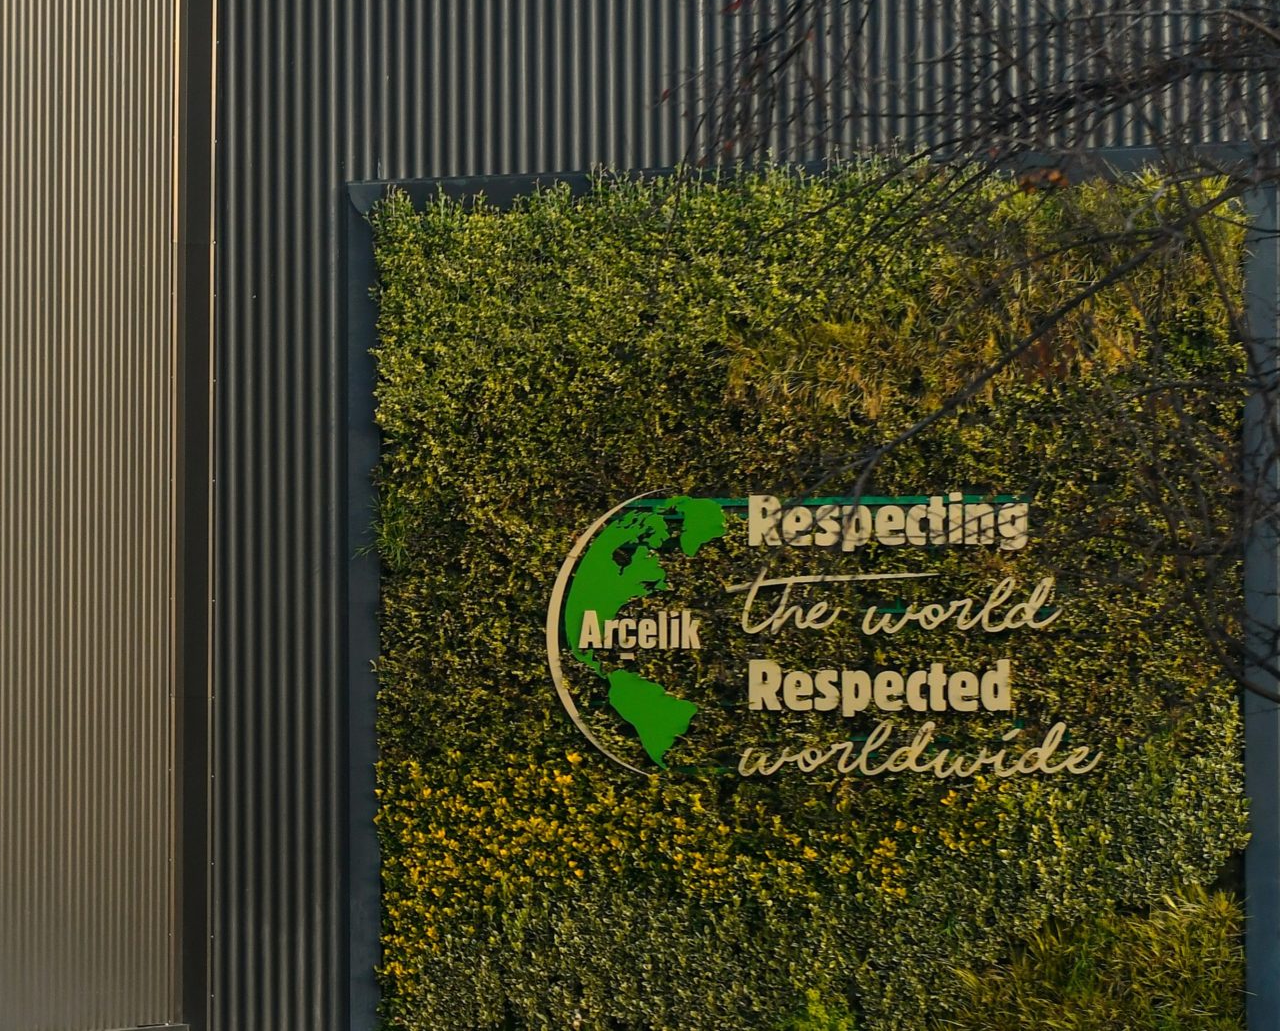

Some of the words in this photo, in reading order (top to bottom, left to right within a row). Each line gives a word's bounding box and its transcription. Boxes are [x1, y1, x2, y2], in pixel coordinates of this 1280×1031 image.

[747, 491, 1030, 552] Respecting
[861, 576, 1063, 636] world
[748, 658, 1012, 718] Respected
[737, 721, 1104, 779] worldwide
